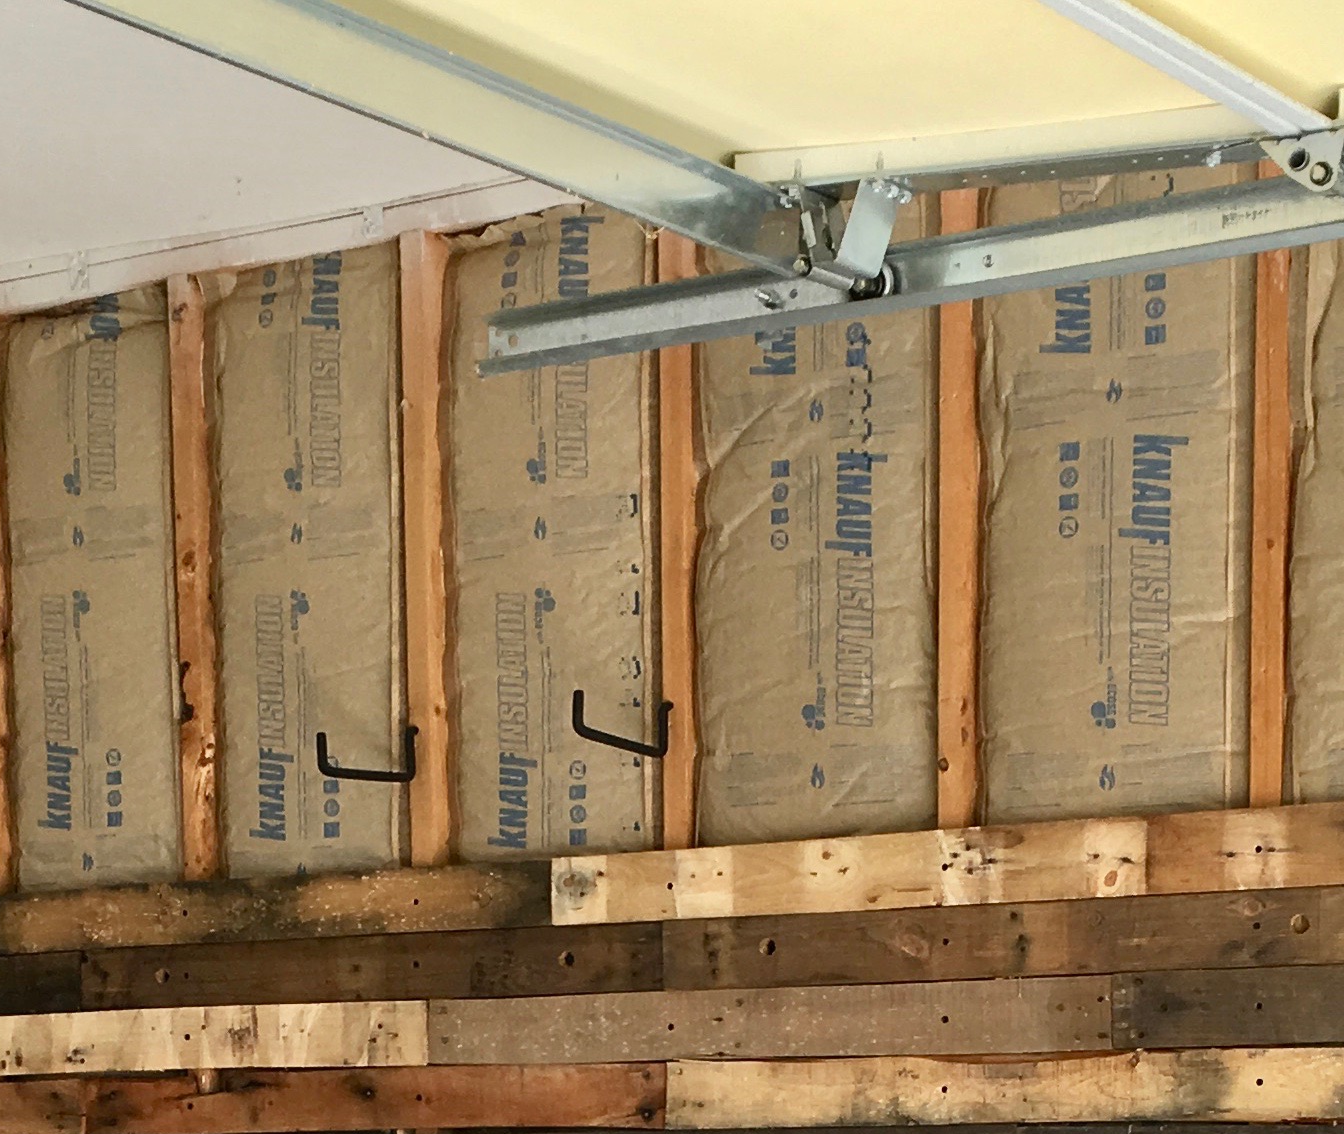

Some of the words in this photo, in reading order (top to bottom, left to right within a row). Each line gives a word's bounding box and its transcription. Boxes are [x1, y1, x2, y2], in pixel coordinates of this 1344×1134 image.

[301, 251, 343, 331] NAUF
[558, 215, 605, 299] KNAU
[1039, 284, 1091, 354] KNA
[825, 451, 888, 558] KNAUF
[1118, 433, 1190, 546] KNAUF
[1128, 545, 1172, 727] INSULATION
[37, 740, 78, 831] KNAUF
[250, 747, 294, 841] KNAUF
[487, 752, 537, 849] KNAUF
